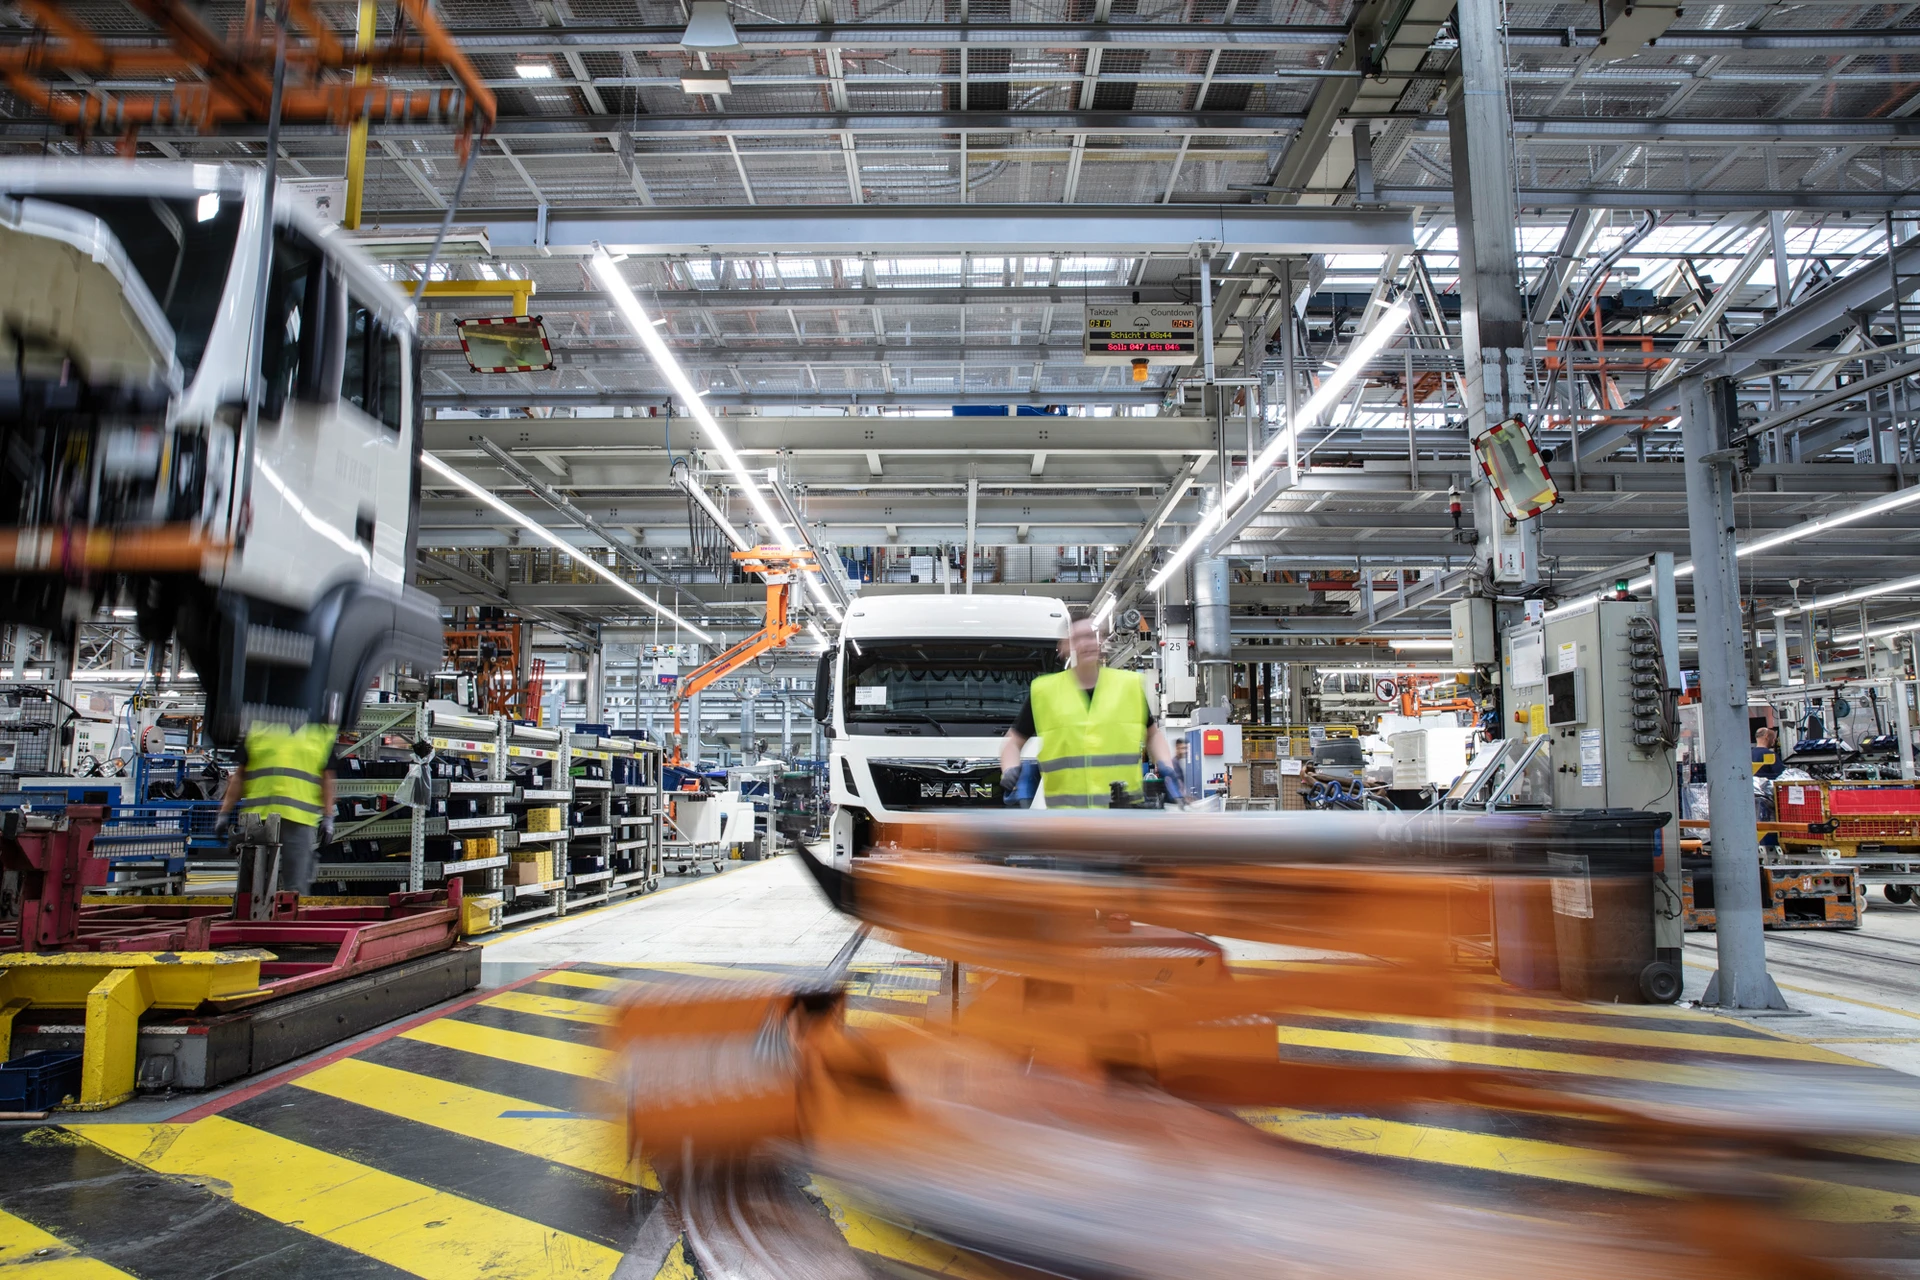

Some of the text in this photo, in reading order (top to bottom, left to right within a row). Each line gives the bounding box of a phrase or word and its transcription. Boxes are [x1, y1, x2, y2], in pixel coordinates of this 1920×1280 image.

[1089, 308, 1118, 316] Taktzeit
[1151, 308, 1194, 316] Countdown
[1111, 331, 1141, 339] Schicht
[1107, 343, 1127, 351] Soll:
[1130, 343, 1145, 351] 047
[1147, 343, 1162, 351] Ist:
[1169, 642, 1181, 651] 25
[920, 782, 993, 798] MAN
